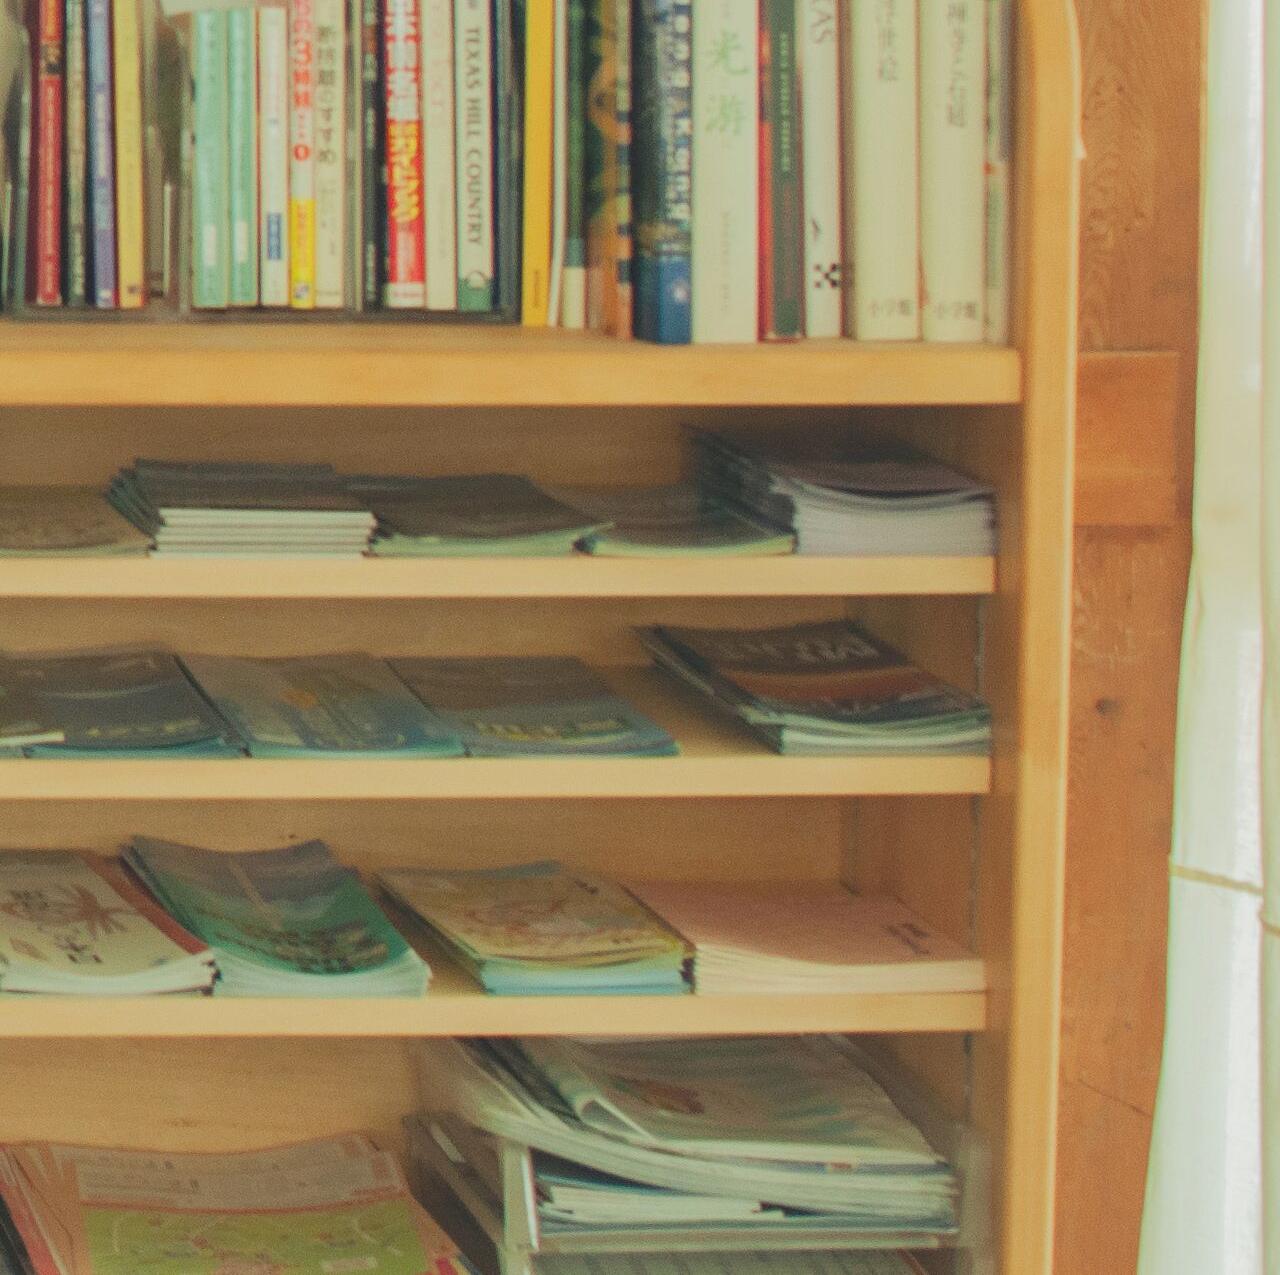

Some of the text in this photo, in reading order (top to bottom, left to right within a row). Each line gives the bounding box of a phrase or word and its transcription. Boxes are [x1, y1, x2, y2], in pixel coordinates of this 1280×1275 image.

[466, 27, 483, 247] TEXAS HILL COUNTRY
